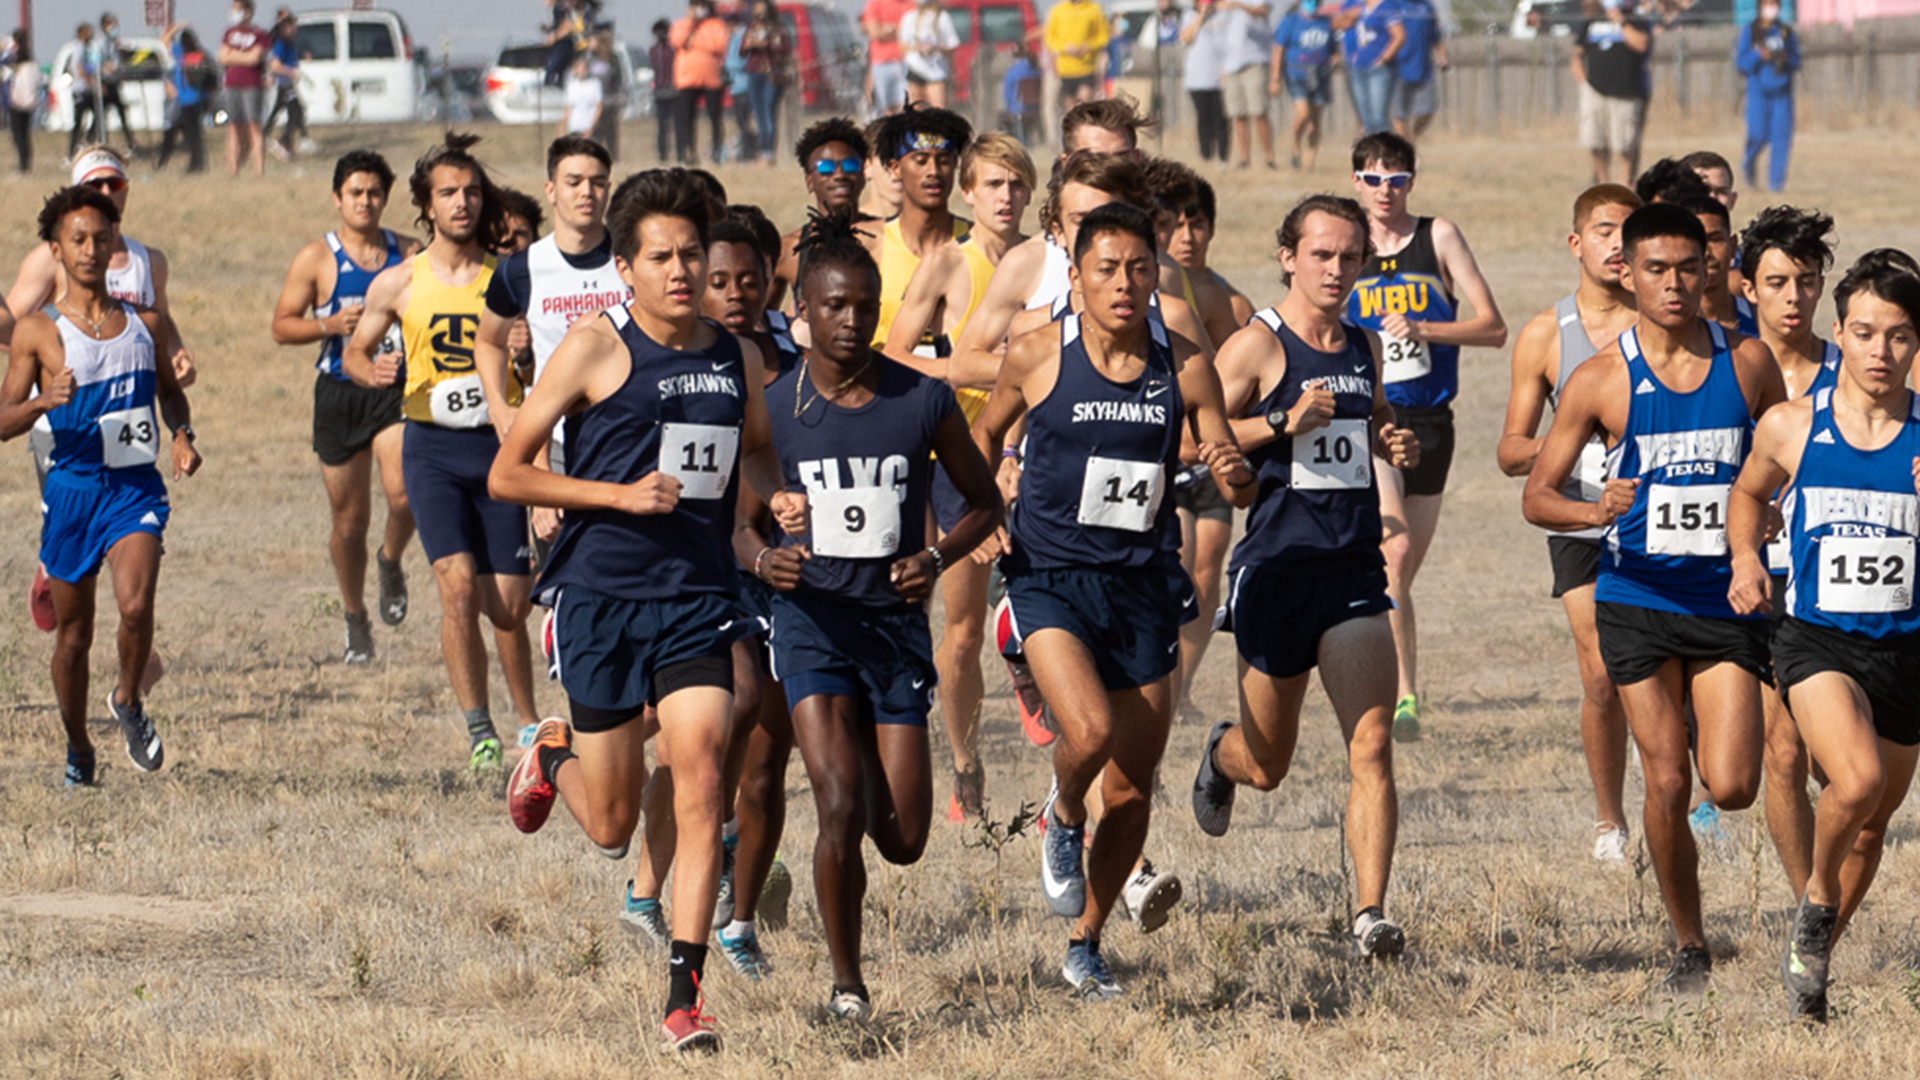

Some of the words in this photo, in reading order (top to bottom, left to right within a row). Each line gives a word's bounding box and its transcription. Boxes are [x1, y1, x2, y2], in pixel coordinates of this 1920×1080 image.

[1357, 282, 1428, 318] WBU
[446, 387, 483, 413] 85
[657, 374, 739, 401] SKYHAWKS
[1072, 401, 1166, 426] SKYHAWKS
[118, 421, 153, 446] 43
[680, 441, 719, 473] 11
[1313, 435, 1353, 464] 10
[1665, 462, 1716, 478] TEXAS
[1103, 476, 1150, 507] 14
[843, 505, 867, 533] 9
[1656, 502, 1725, 530] 151
[1830, 555, 1905, 585] 152
